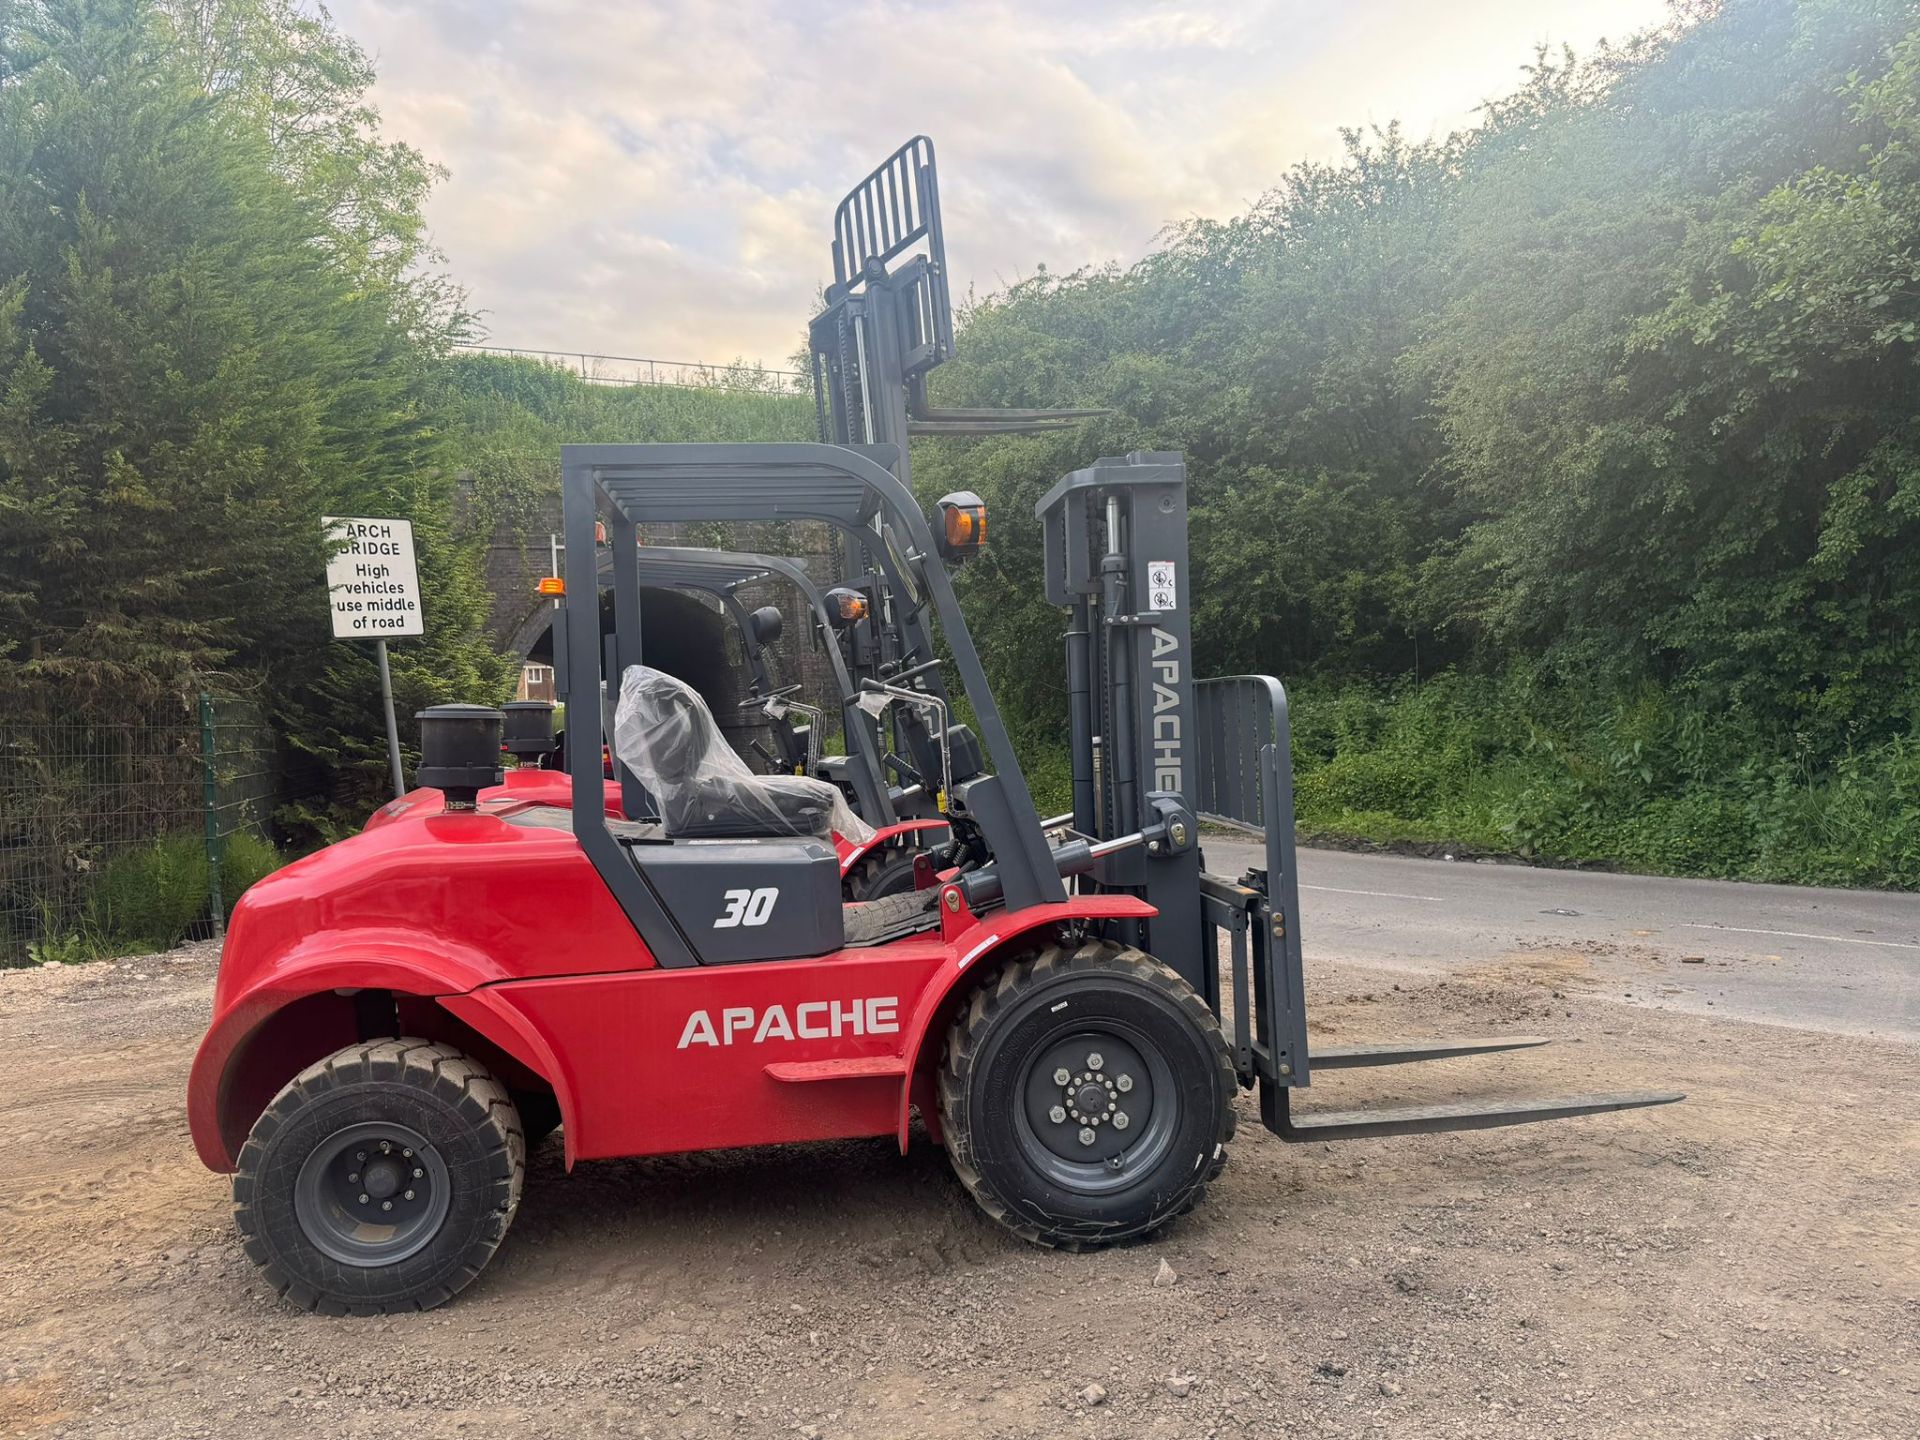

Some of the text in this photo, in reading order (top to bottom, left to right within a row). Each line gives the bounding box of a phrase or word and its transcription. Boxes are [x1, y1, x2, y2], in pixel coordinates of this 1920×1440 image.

[346, 523, 391, 538] ARCH
[355, 563, 390, 579] High
[345, 581, 404, 594] vehicles
[337, 598, 415, 612] use middle
[353, 615, 405, 629] of road
[1151, 626, 1182, 793] APACHE
[713, 887, 779, 929] 30
[676, 996, 899, 1049] APACHE
